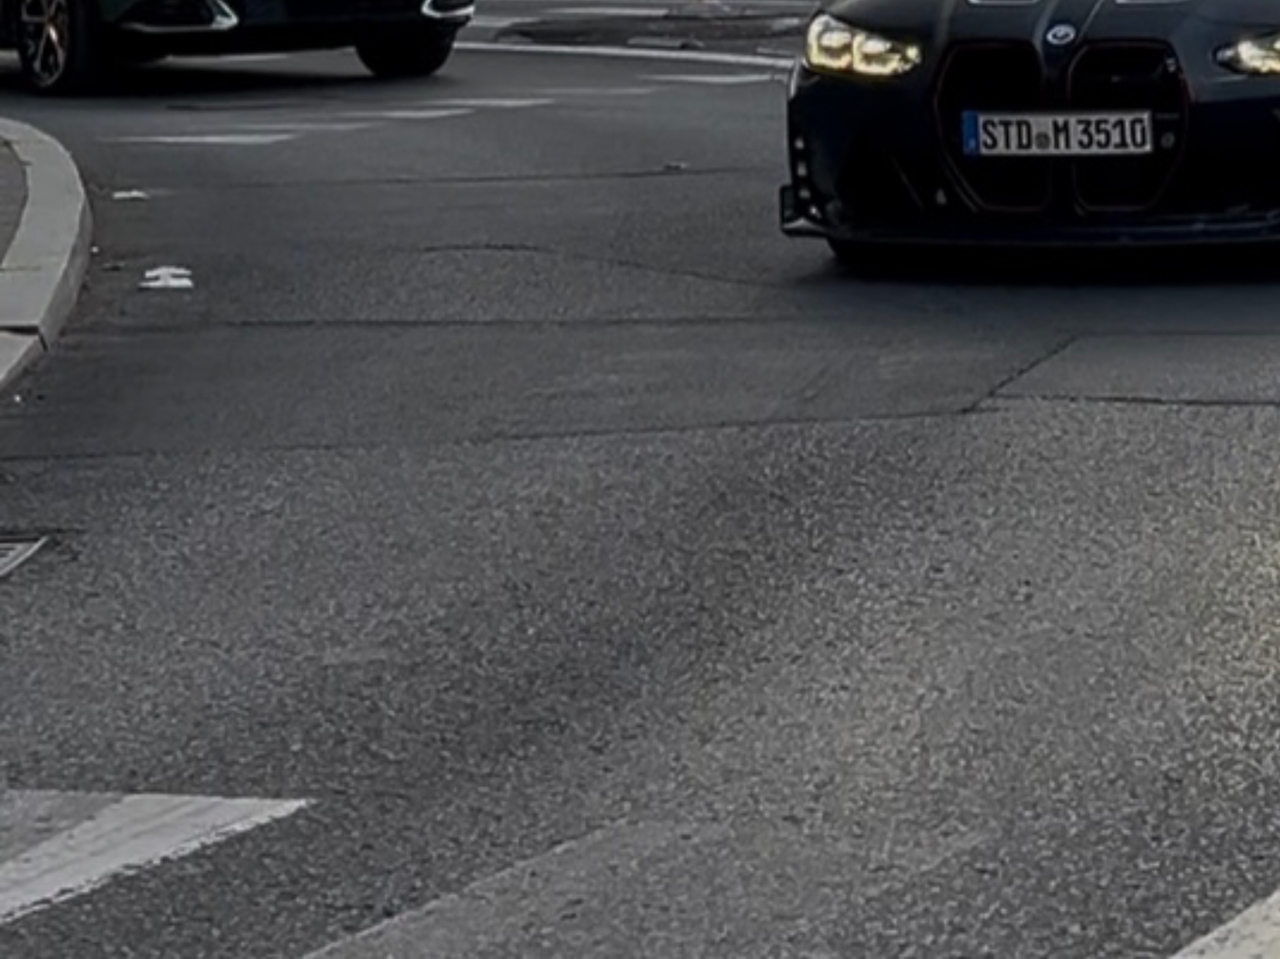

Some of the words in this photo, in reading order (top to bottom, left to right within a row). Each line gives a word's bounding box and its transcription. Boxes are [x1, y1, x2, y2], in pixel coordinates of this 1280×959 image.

[982, 119, 1033, 150] STD
[1052, 119, 1071, 149] M
[1076, 118, 1147, 150] 3510
